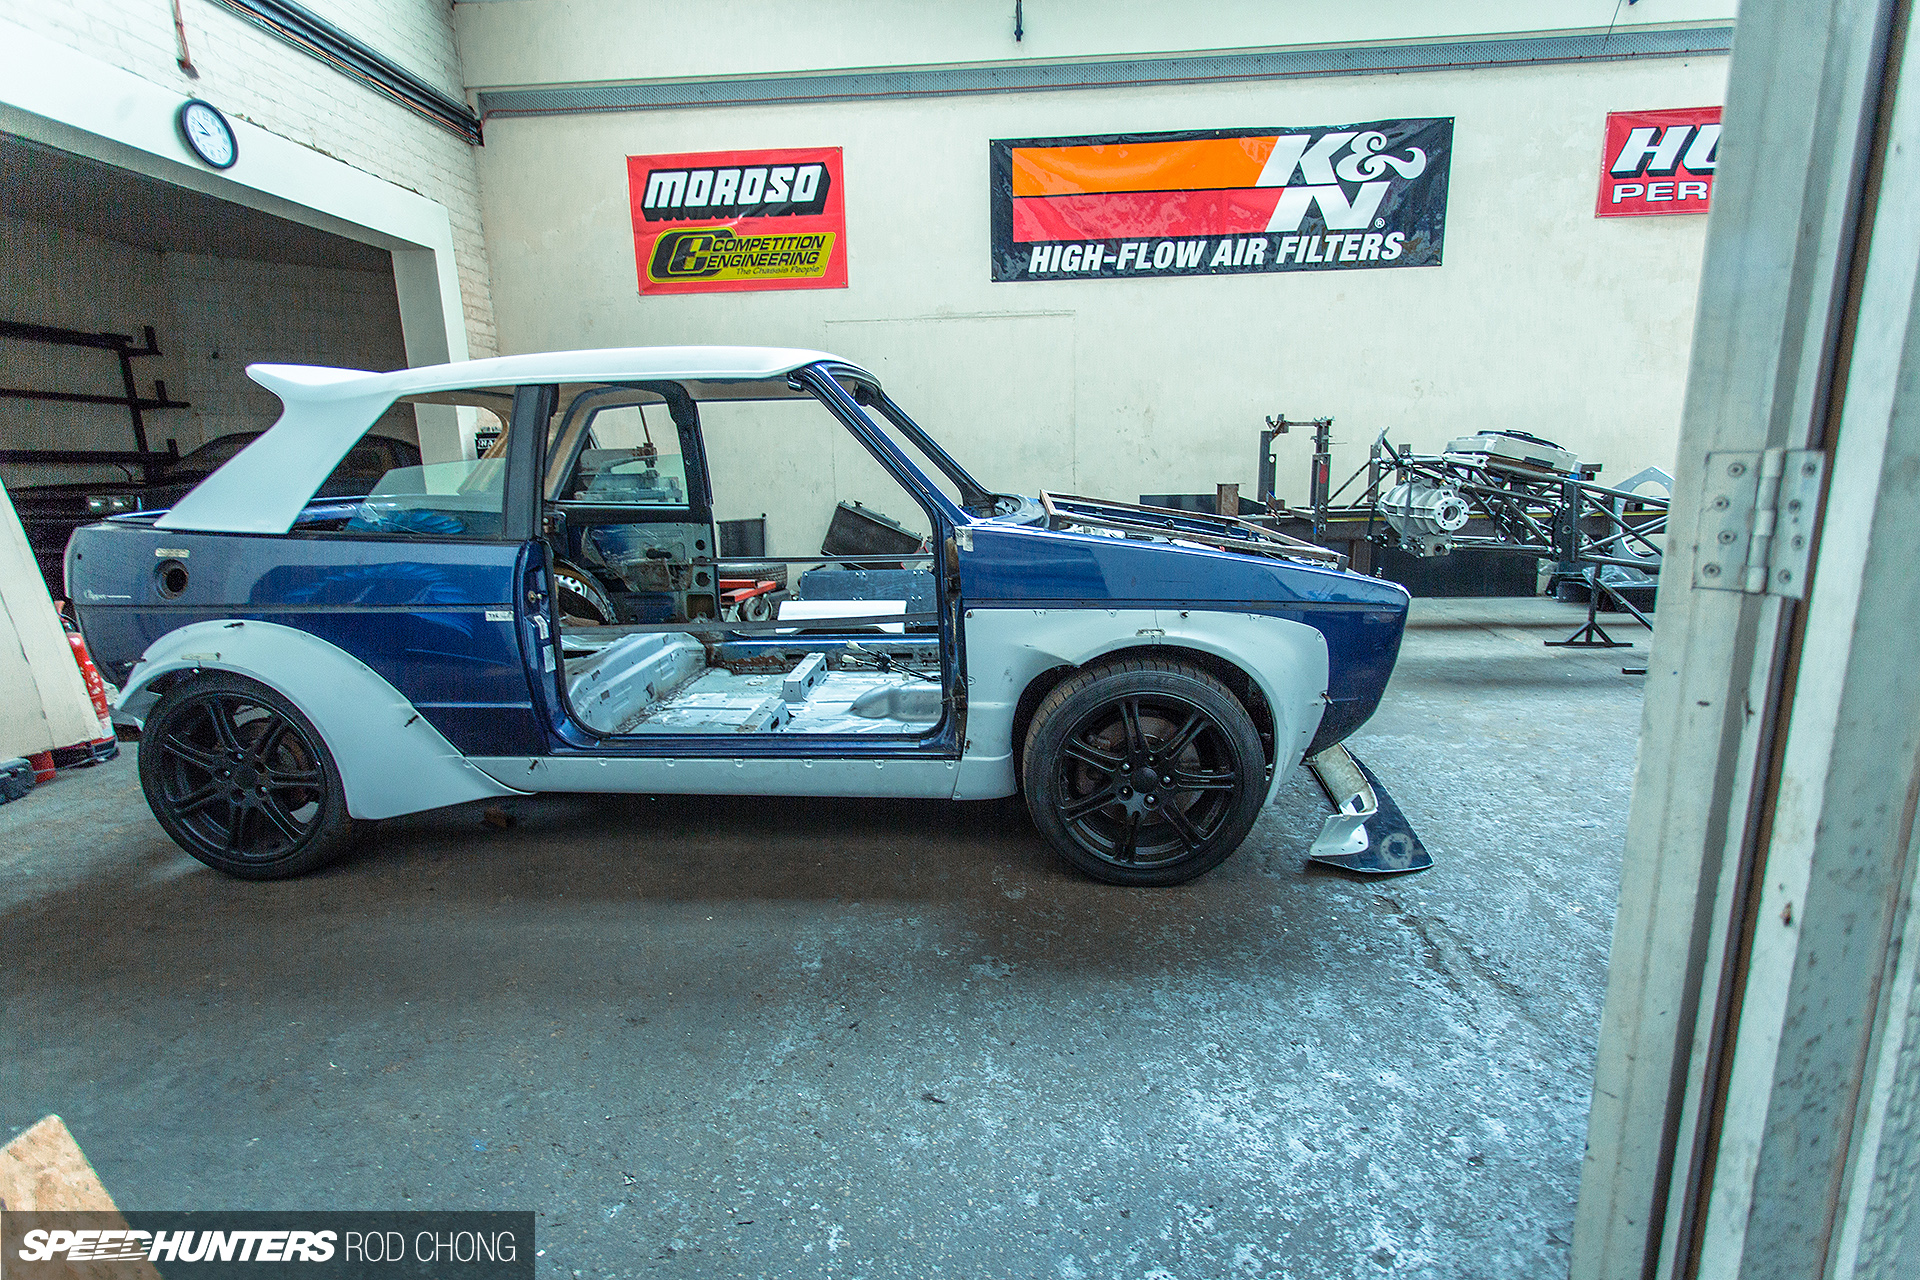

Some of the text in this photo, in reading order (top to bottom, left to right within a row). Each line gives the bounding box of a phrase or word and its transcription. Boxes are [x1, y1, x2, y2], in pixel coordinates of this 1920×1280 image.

[643, 164, 824, 211] MOROSO
[1612, 181, 1708, 204] PER
[712, 235, 826, 252] COMPETITION
[1028, 232, 1405, 273] HIGH-FLOW AIR FILTERS
[706, 251, 820, 269] ENGINEERING
[736, 264, 820, 277] The Chassis People
